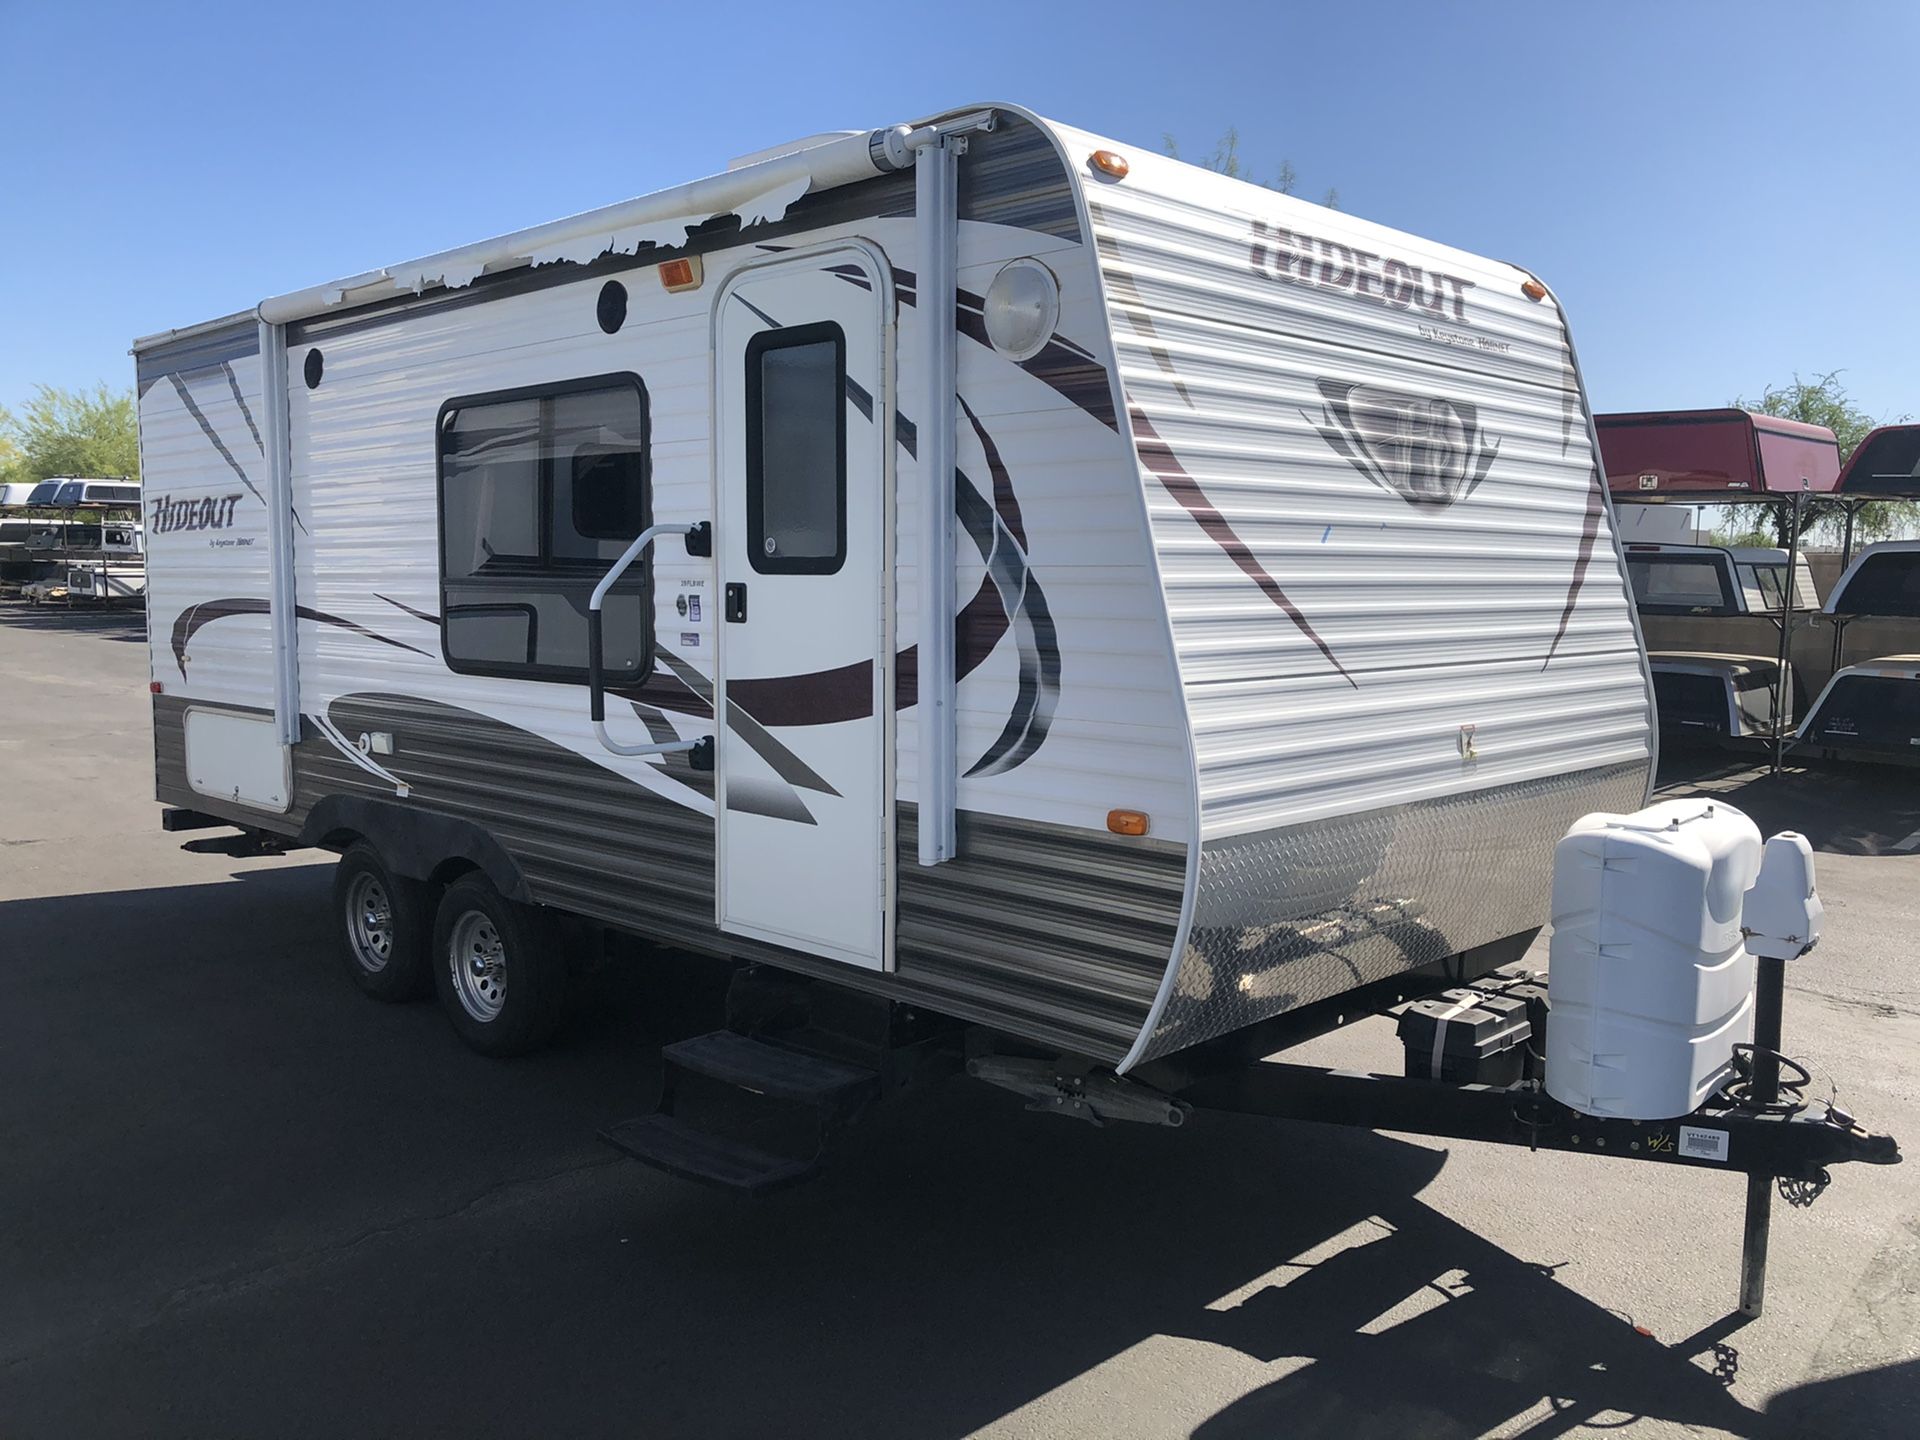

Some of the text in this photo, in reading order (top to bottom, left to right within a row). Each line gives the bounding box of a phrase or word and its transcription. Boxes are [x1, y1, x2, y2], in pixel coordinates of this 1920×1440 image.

[1250, 219, 1476, 324] HIDEOUT
[1417, 324, 1432, 341] by
[150, 494, 243, 535] HIDEOUT
